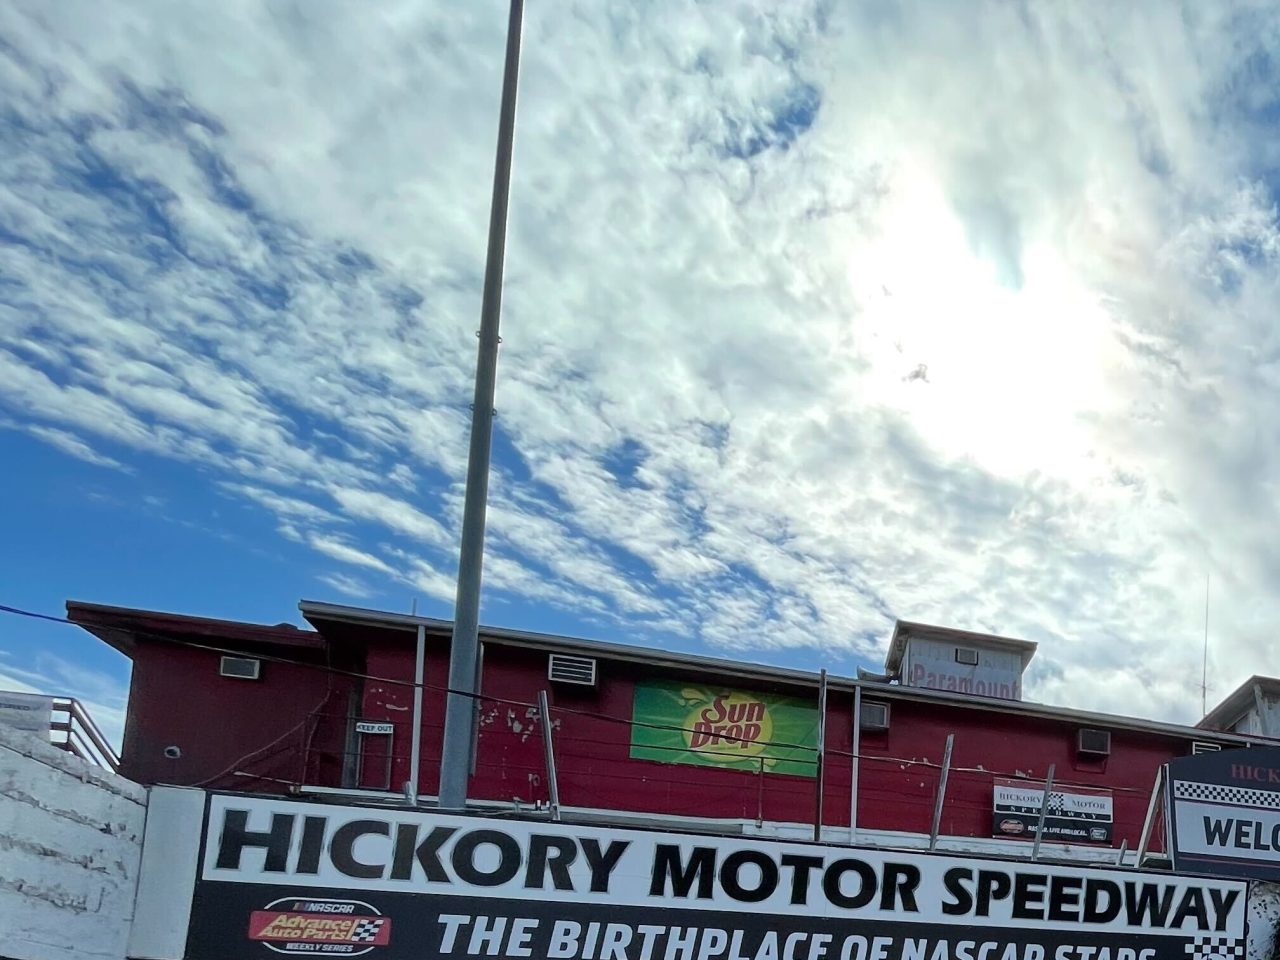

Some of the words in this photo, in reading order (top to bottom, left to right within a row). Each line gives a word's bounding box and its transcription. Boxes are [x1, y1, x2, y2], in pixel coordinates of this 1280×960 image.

[913, 664, 1018, 698] Paramount
[700, 690, 765, 723] Sun
[689, 720, 762, 749] Drop
[999, 791, 1041, 803] HICKORY
[1072, 799, 1106, 810] MOTOR
[1010, 806, 1097, 819] SPEDWAY
[213, 807, 631, 895] HICKORY
[649, 843, 922, 913] MOTOR
[941, 865, 1240, 932] SPEEDWAY
[309, 902, 355, 914] NASCAR
[273, 914, 351, 932] Advance
[262, 926, 300, 939] Auto
[301, 927, 348, 941] Parts
[437, 913, 543, 957] THE
[322, 943, 355, 954] SERIES
